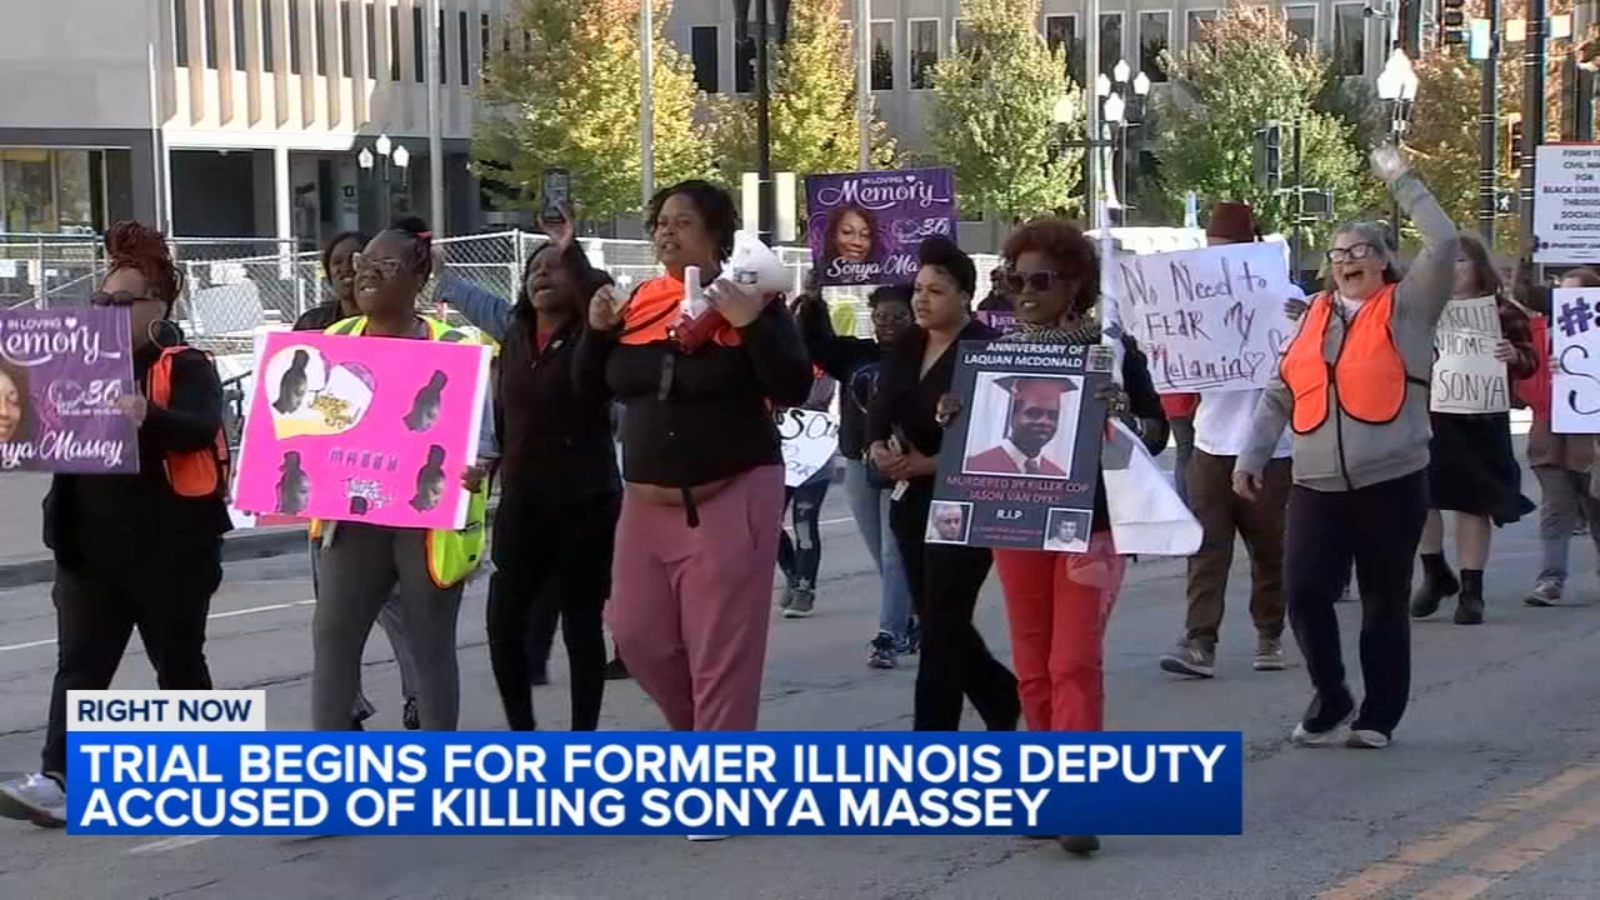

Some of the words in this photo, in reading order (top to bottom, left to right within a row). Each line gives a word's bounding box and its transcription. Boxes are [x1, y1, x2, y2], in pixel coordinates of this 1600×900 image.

[818, 178, 950, 210] Memory
[1543, 186, 1572, 194] BLACK
[826, 256, 881, 281] Sonya
[883, 254, 919, 275] Ma
[1170, 255, 1236, 302] Need
[1238, 260, 1267, 293] to
[20, 318, 61, 330] LOVING
[0, 325, 121, 366] emory
[986, 342, 1067, 355] ANNIVERSARY
[1068, 345, 1086, 355] OF
[964, 353, 1013, 366] LAQUAN
[1014, 356, 1083, 368] MCDONALD
[1438, 369, 1507, 411] SONYA
[39, 429, 123, 467] Massey
